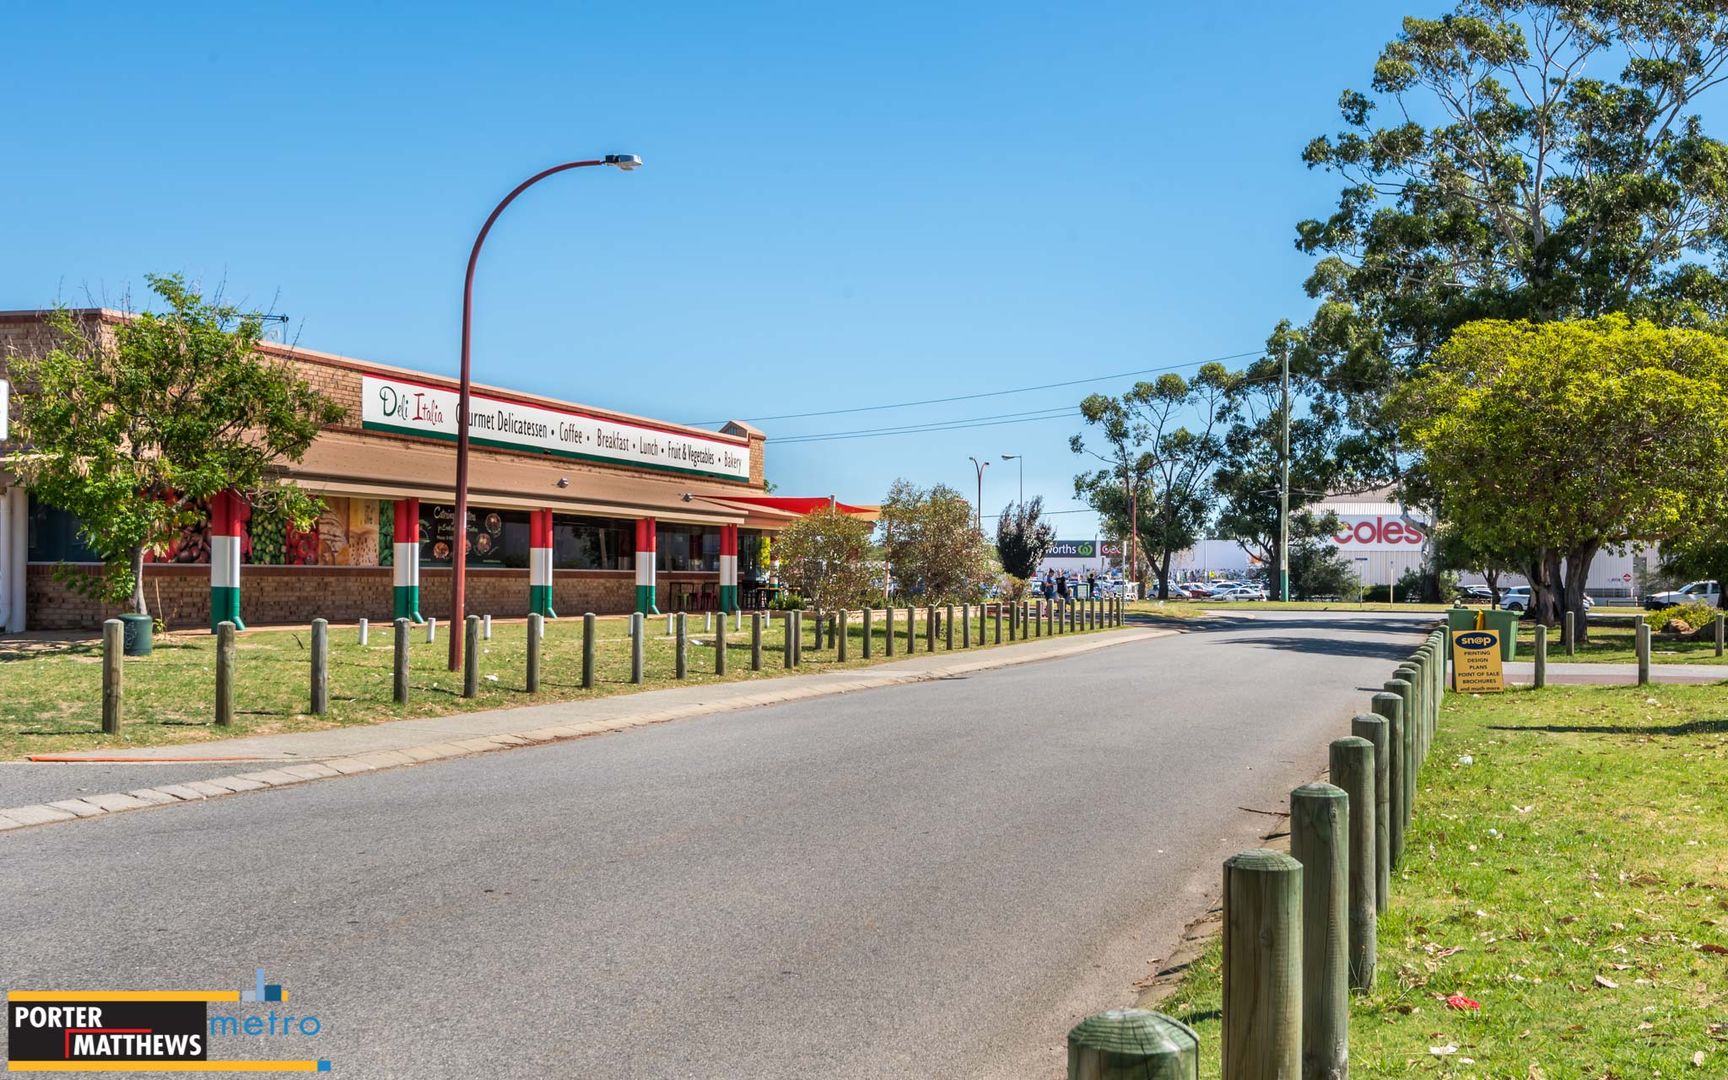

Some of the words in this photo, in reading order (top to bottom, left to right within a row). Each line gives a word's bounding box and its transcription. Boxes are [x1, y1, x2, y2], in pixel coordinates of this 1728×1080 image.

[379, 386, 409, 421] Deli
[412, 393, 443, 425] Italia
[455, 403, 494, 430] Gurmet
[497, 410, 547, 438] Delicatessen
[559, 421, 582, 444] Coffee
[597, 428, 629, 451] Breakfast
[640, 436, 658, 456] Lunch
[668, 440, 681, 460] Fruit
[682, 443, 686, 460] &
[687, 444, 714, 467] Vegetables
[724, 450, 742, 474] Bakery
[1333, 517, 1422, 544] coles
[1461, 636, 1491, 646] sn@p
